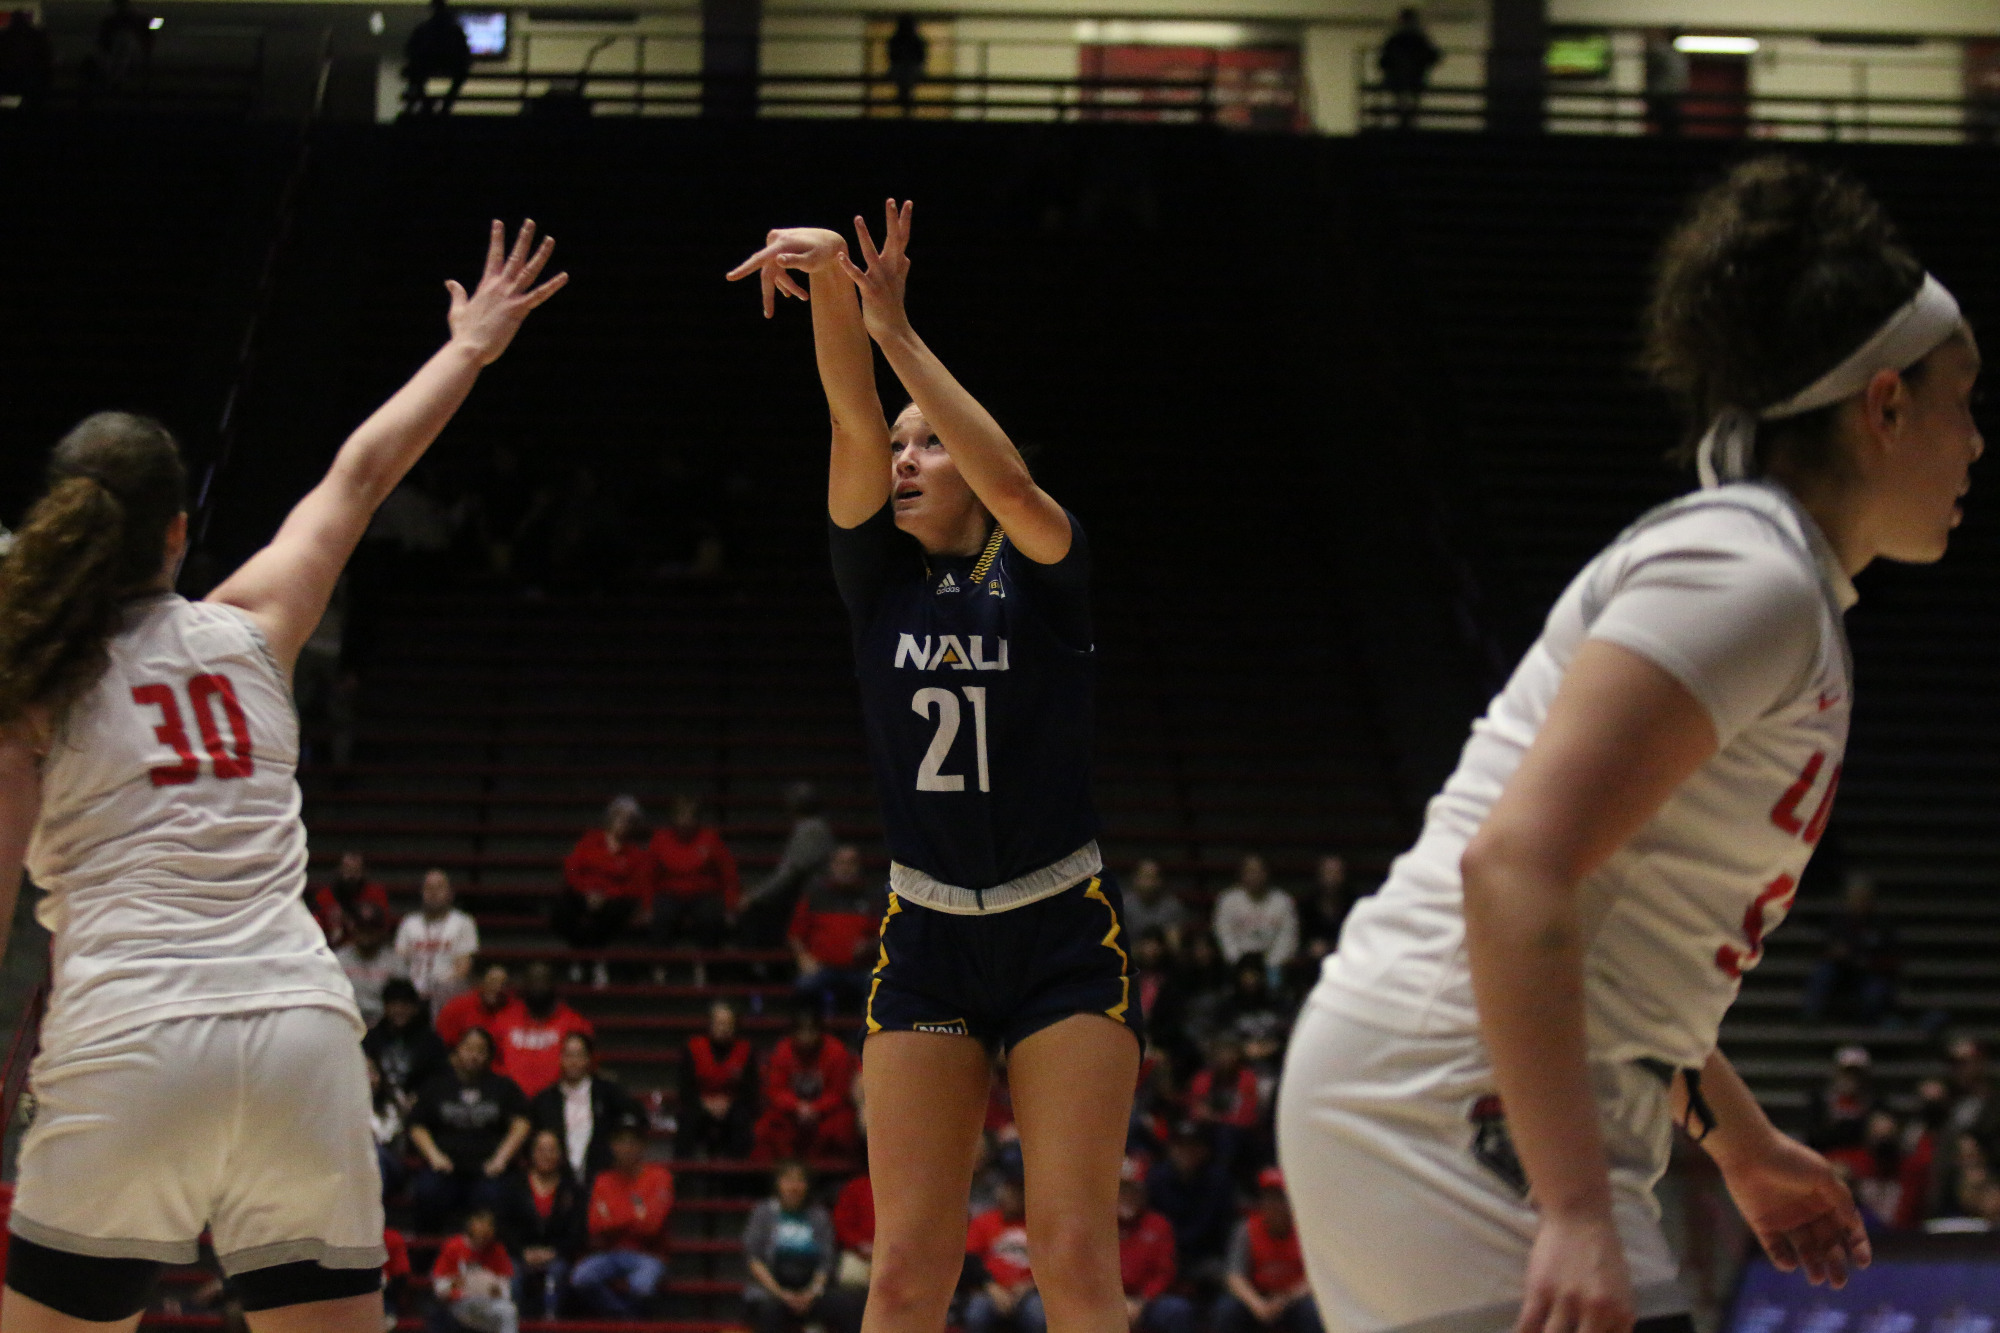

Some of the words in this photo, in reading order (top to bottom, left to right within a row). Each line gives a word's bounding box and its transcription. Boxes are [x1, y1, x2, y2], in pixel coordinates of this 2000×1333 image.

[936, 586, 960, 595] adidas
[894, 632, 1010, 671] NAU
[131, 672, 255, 787] 30
[911, 686, 990, 793] 21
